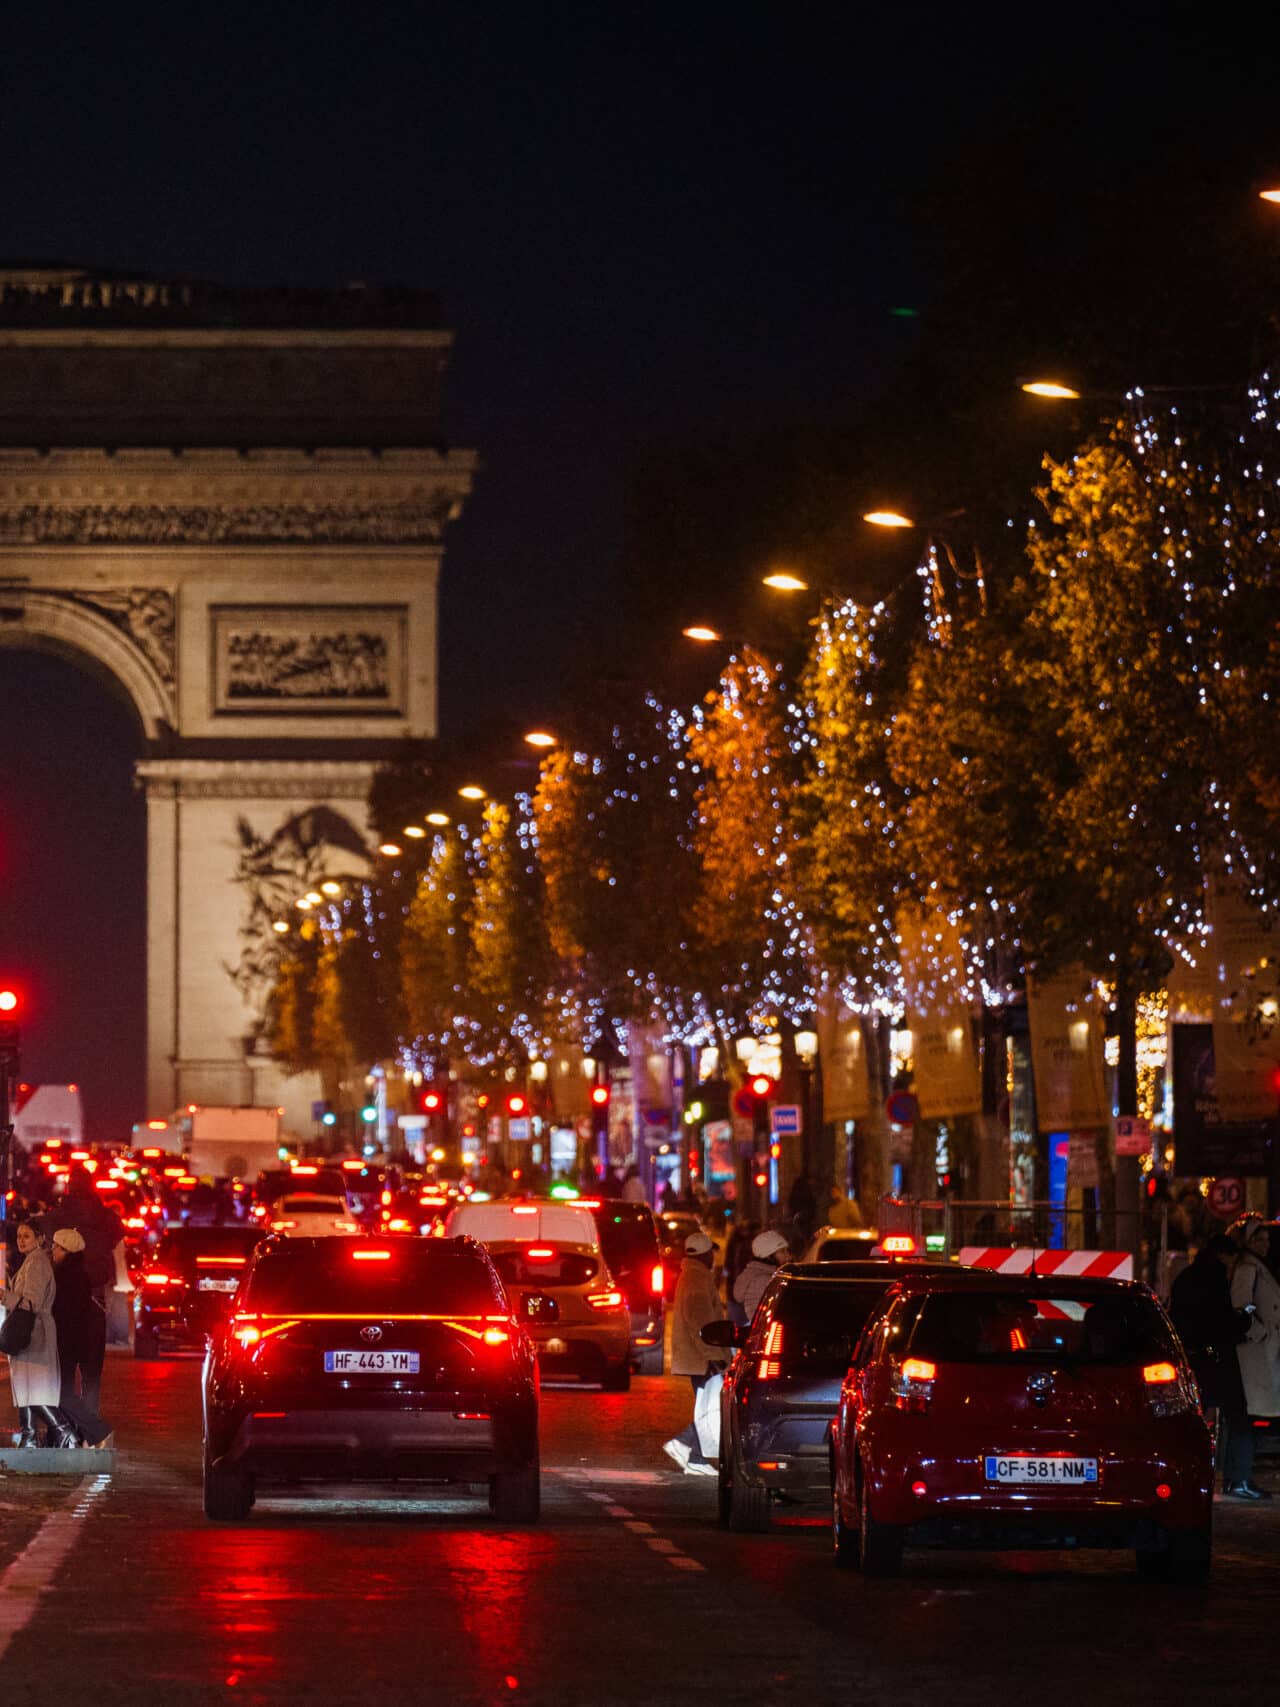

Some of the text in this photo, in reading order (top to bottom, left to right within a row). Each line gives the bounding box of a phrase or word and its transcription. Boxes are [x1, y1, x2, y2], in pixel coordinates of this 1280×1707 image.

[1216, 1184, 1240, 1203] 30
[336, 1354, 408, 1368] HF-443-YM
[998, 1461, 1085, 1478] CF-581-NM
